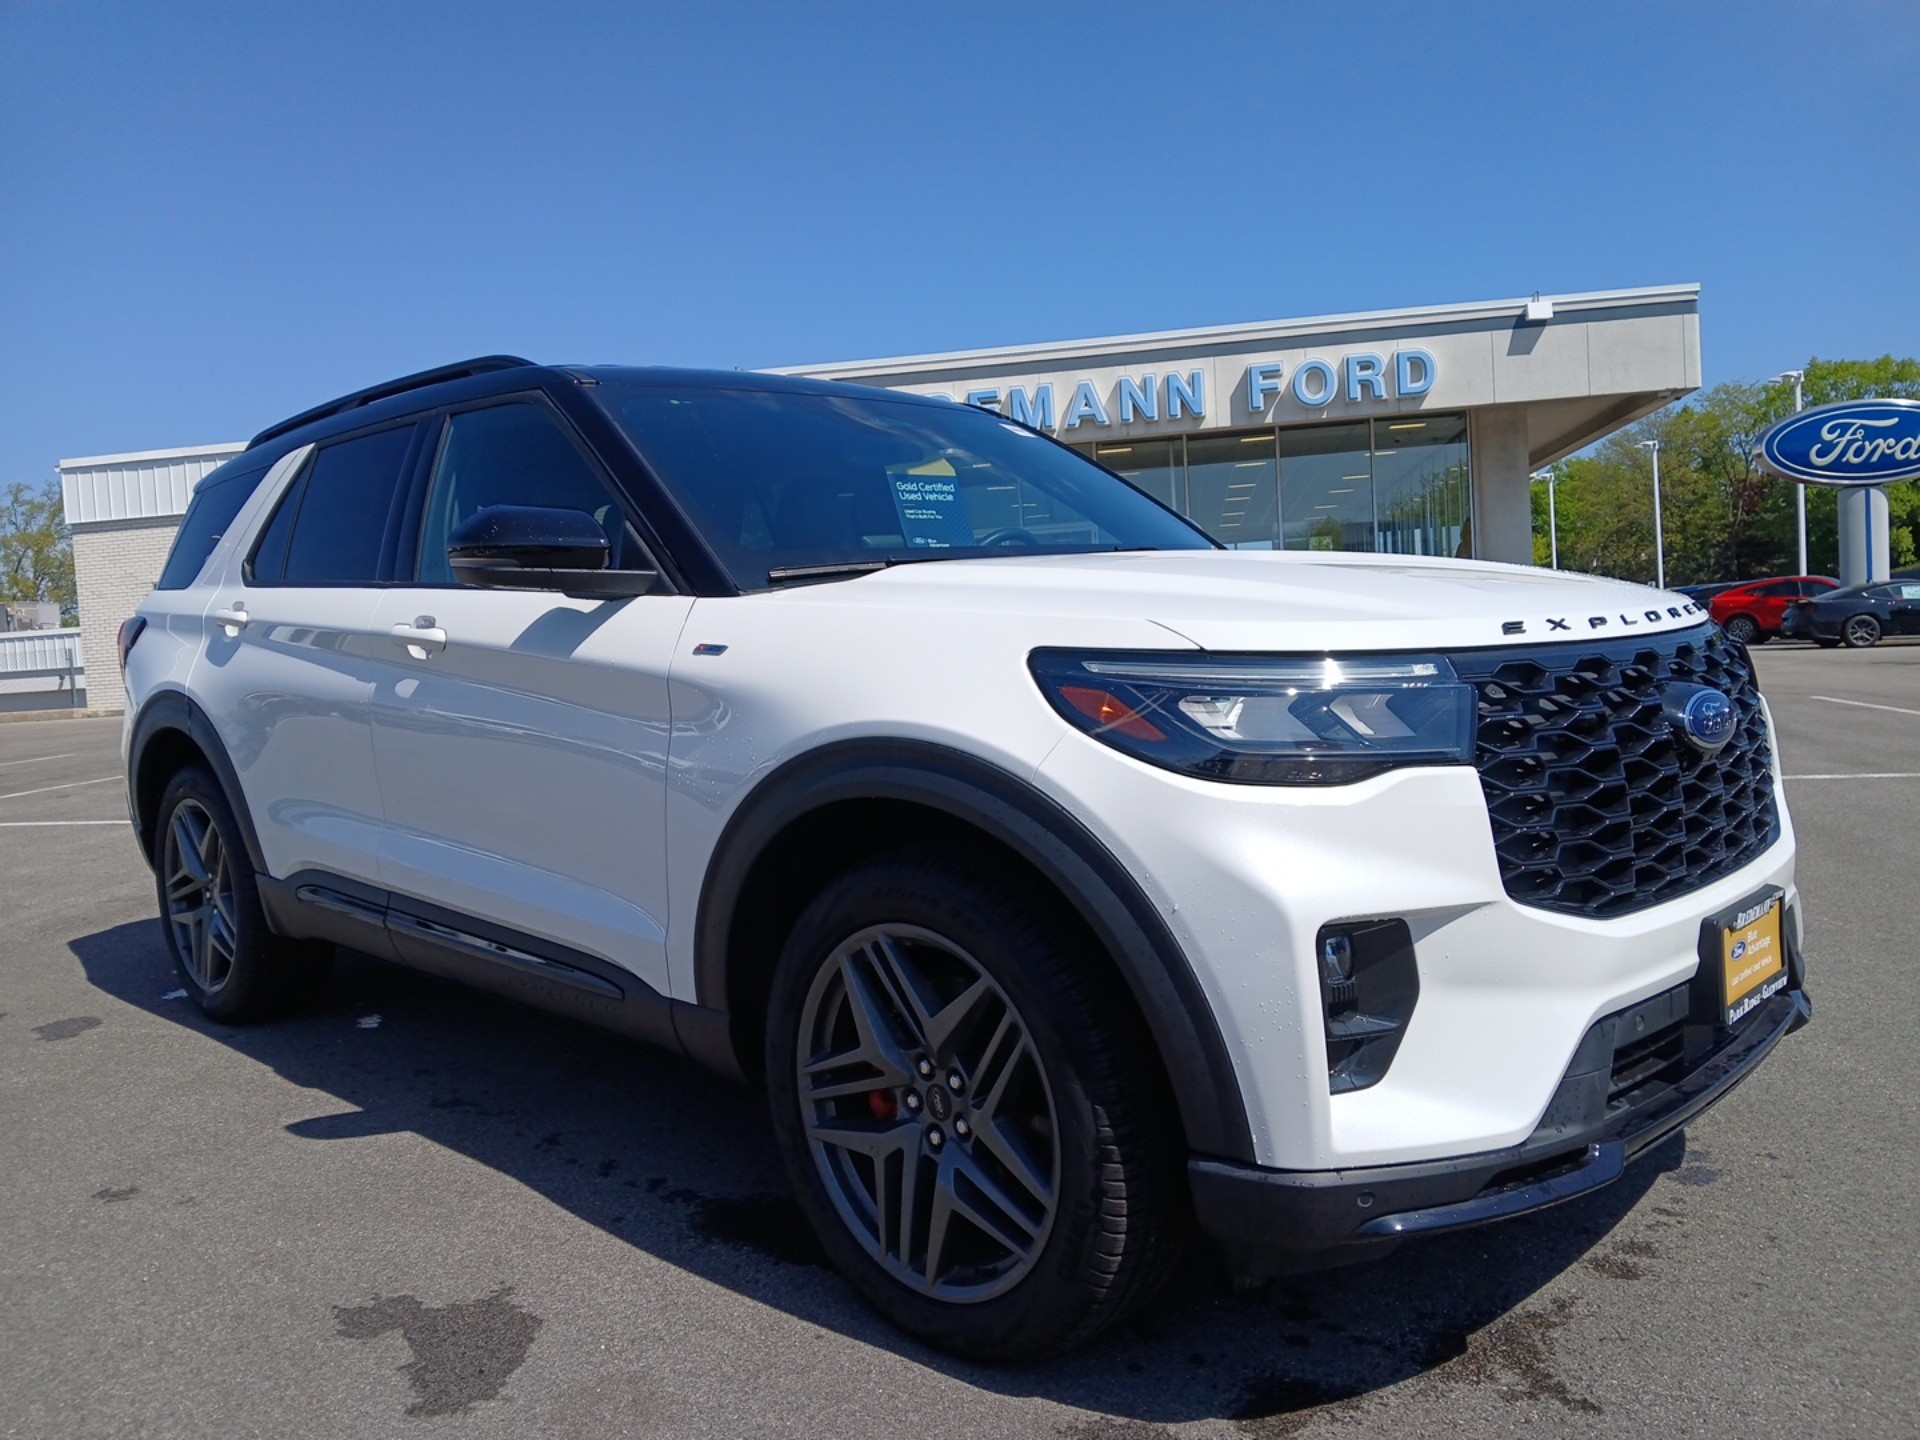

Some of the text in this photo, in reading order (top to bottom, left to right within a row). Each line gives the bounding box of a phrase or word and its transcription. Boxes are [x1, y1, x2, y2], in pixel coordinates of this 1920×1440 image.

[1247, 348, 1439, 412] FORD
[1809, 416, 1920, 467] Ford
[896, 481, 955, 492] Gold Certified
[898, 491, 954, 501] Used Vehicle
